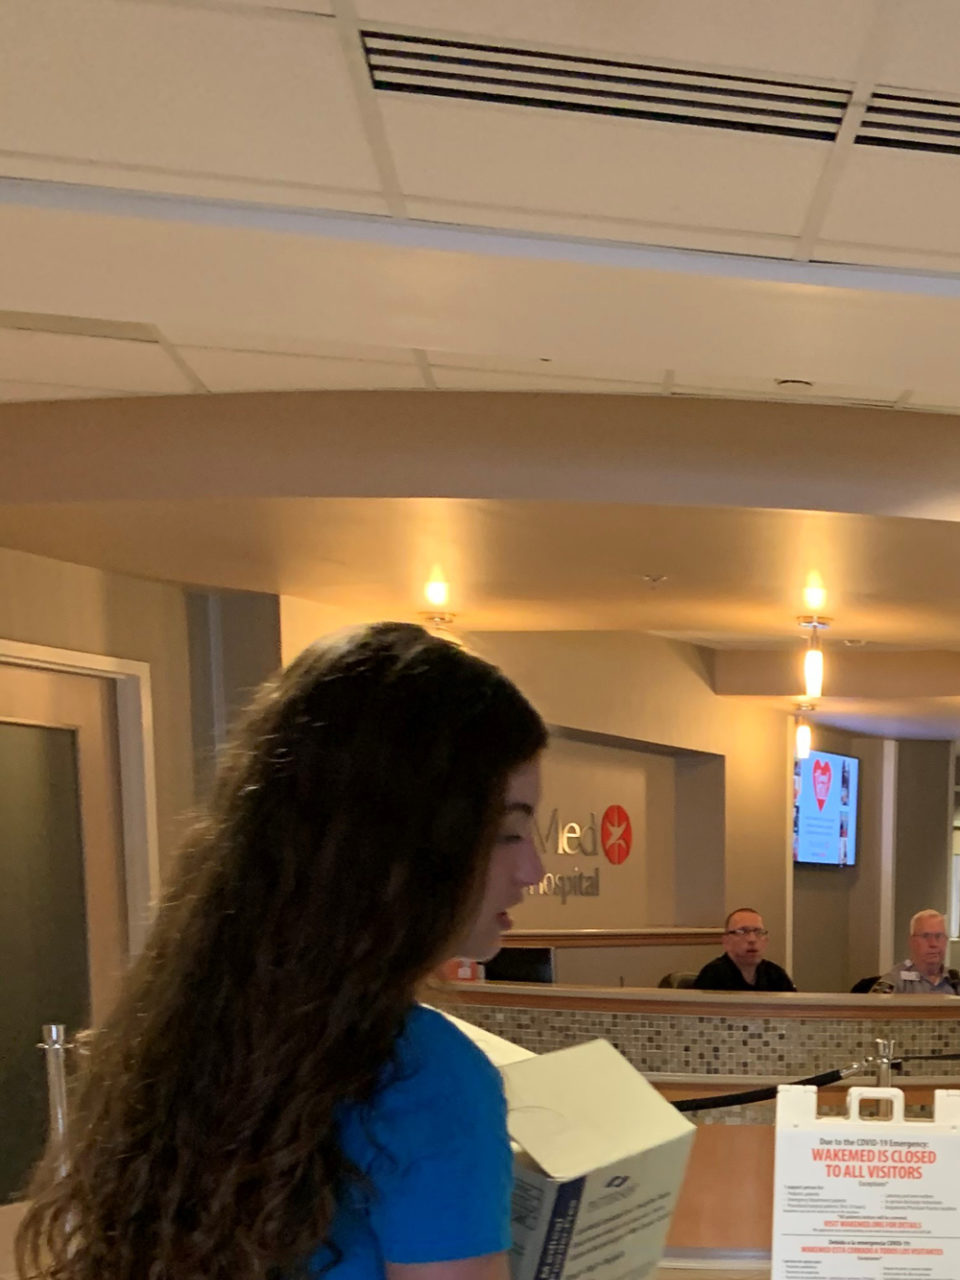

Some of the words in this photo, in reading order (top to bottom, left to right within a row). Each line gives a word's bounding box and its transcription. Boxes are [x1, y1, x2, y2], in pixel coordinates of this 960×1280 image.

[819, 1138, 834, 1146] Due
[843, 1138, 855, 1146] the
[856, 1139, 889, 1147] COVID-19
[811, 1148, 876, 1163] WAKEMED
[878, 1149, 889, 1163] IS
[891, 1150, 937, 1164] CLOSED
[825, 1164, 842, 1178] TO
[843, 1165, 865, 1178] ALL
[867, 1166, 923, 1180] VISITORS
